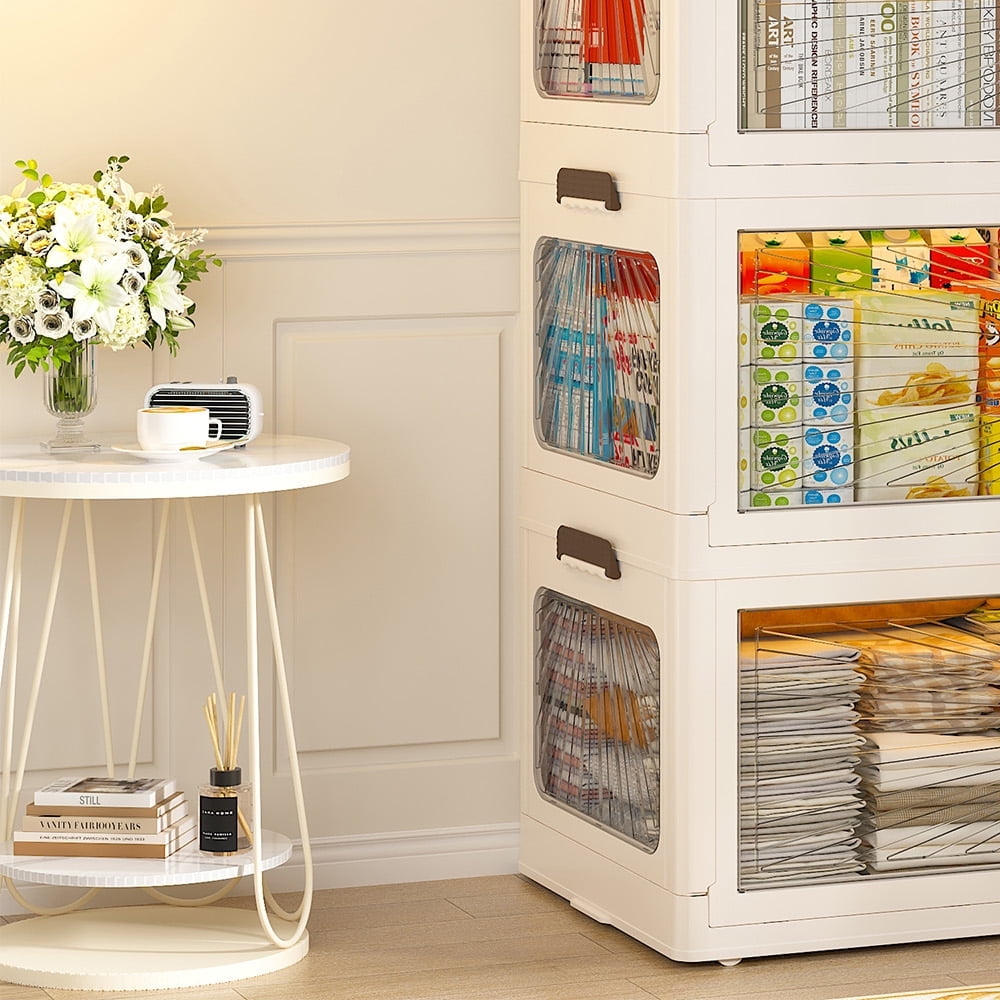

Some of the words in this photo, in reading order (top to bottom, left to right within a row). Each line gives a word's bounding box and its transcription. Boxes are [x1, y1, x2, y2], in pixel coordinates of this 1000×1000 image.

[768, 15, 779, 48] ART
[783, 15, 794, 48] ART
[811, 31, 819, 67] DESIGN
[911, 16, 921, 56] BOOK
[825, 49, 833, 103] BORDEAUX
[911, 72, 921, 128] SYMBO
[79, 795, 101, 805] STILL
